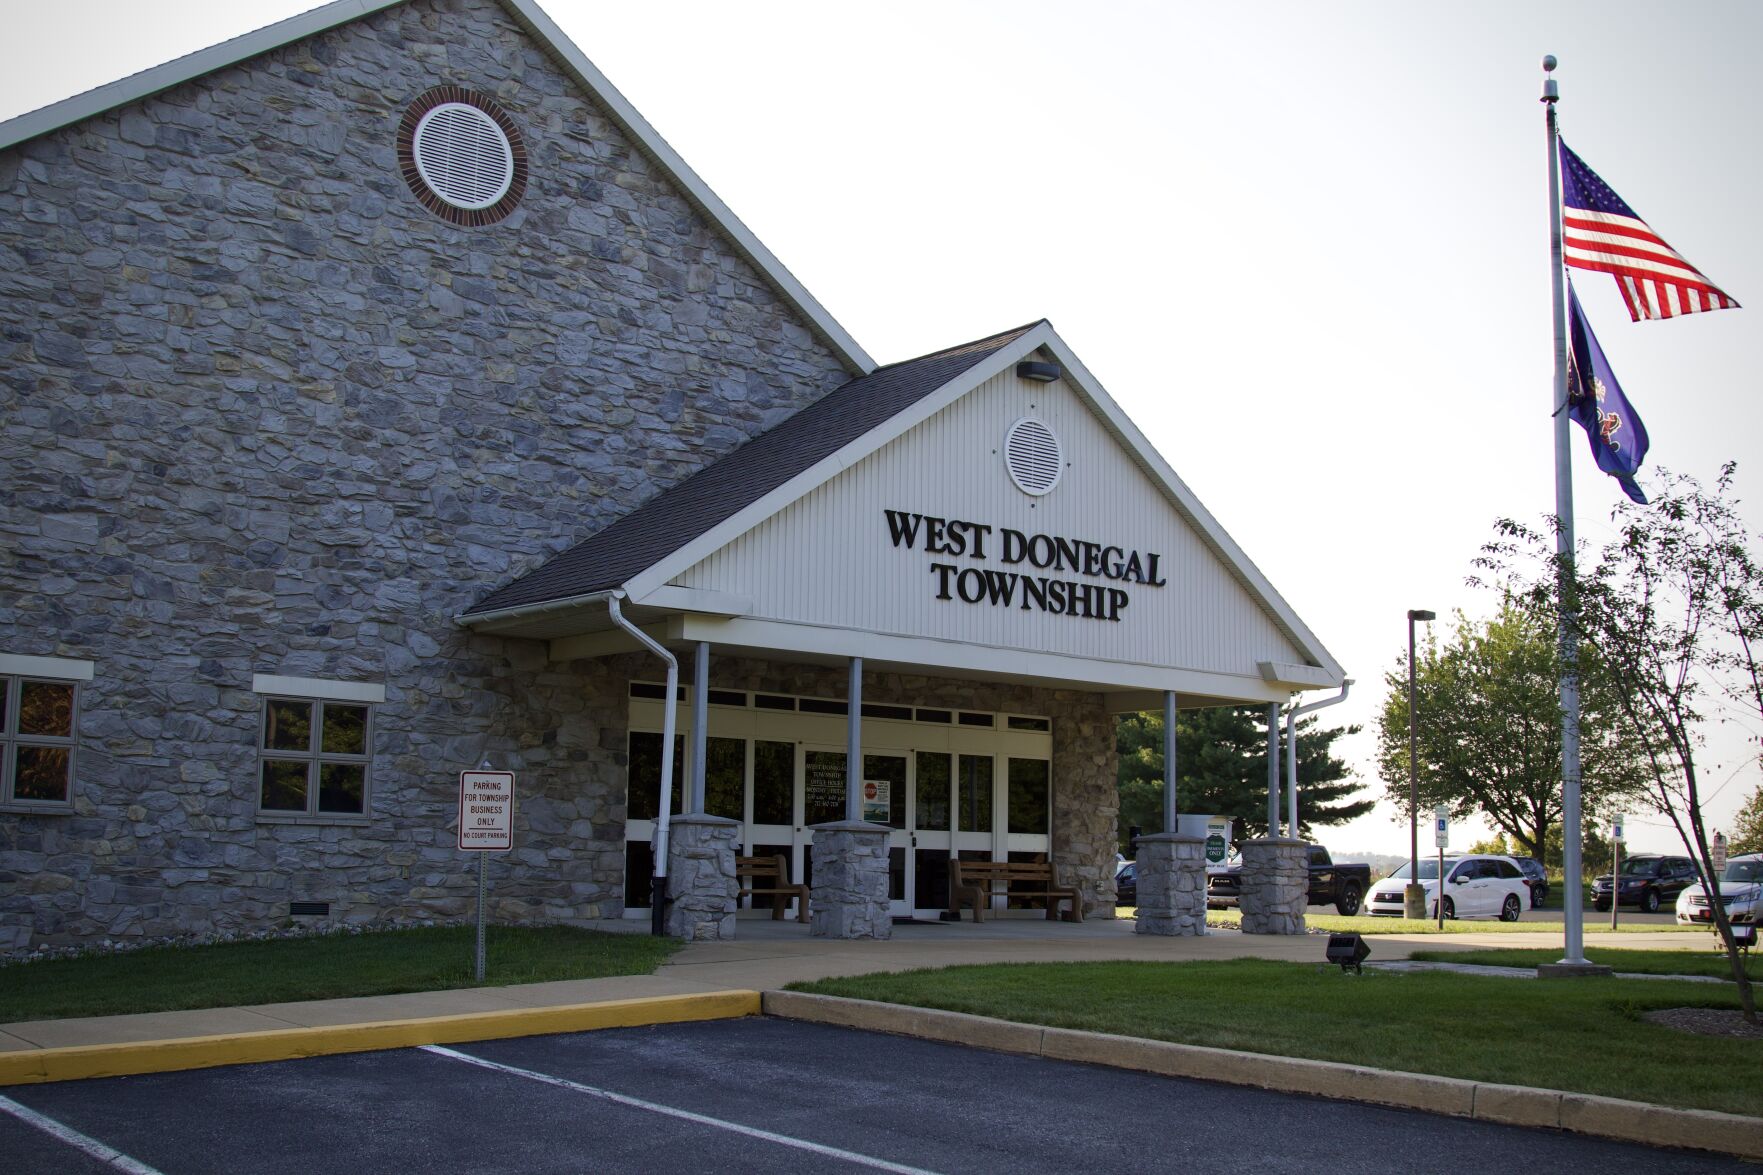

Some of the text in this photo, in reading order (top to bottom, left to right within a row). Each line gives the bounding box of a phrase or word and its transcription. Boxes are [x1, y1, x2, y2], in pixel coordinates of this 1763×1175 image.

[884, 509, 1167, 587] WEST DONEGAL
[931, 563, 1129, 622] TOWNSHIP
[812, 771, 842, 779] TOWNSHIP
[473, 781, 502, 791] PARKING
[464, 793, 510, 803] FOR TOWNSHIP
[470, 805, 503, 814] BUSINESS
[477, 817, 495, 826] ONLY
